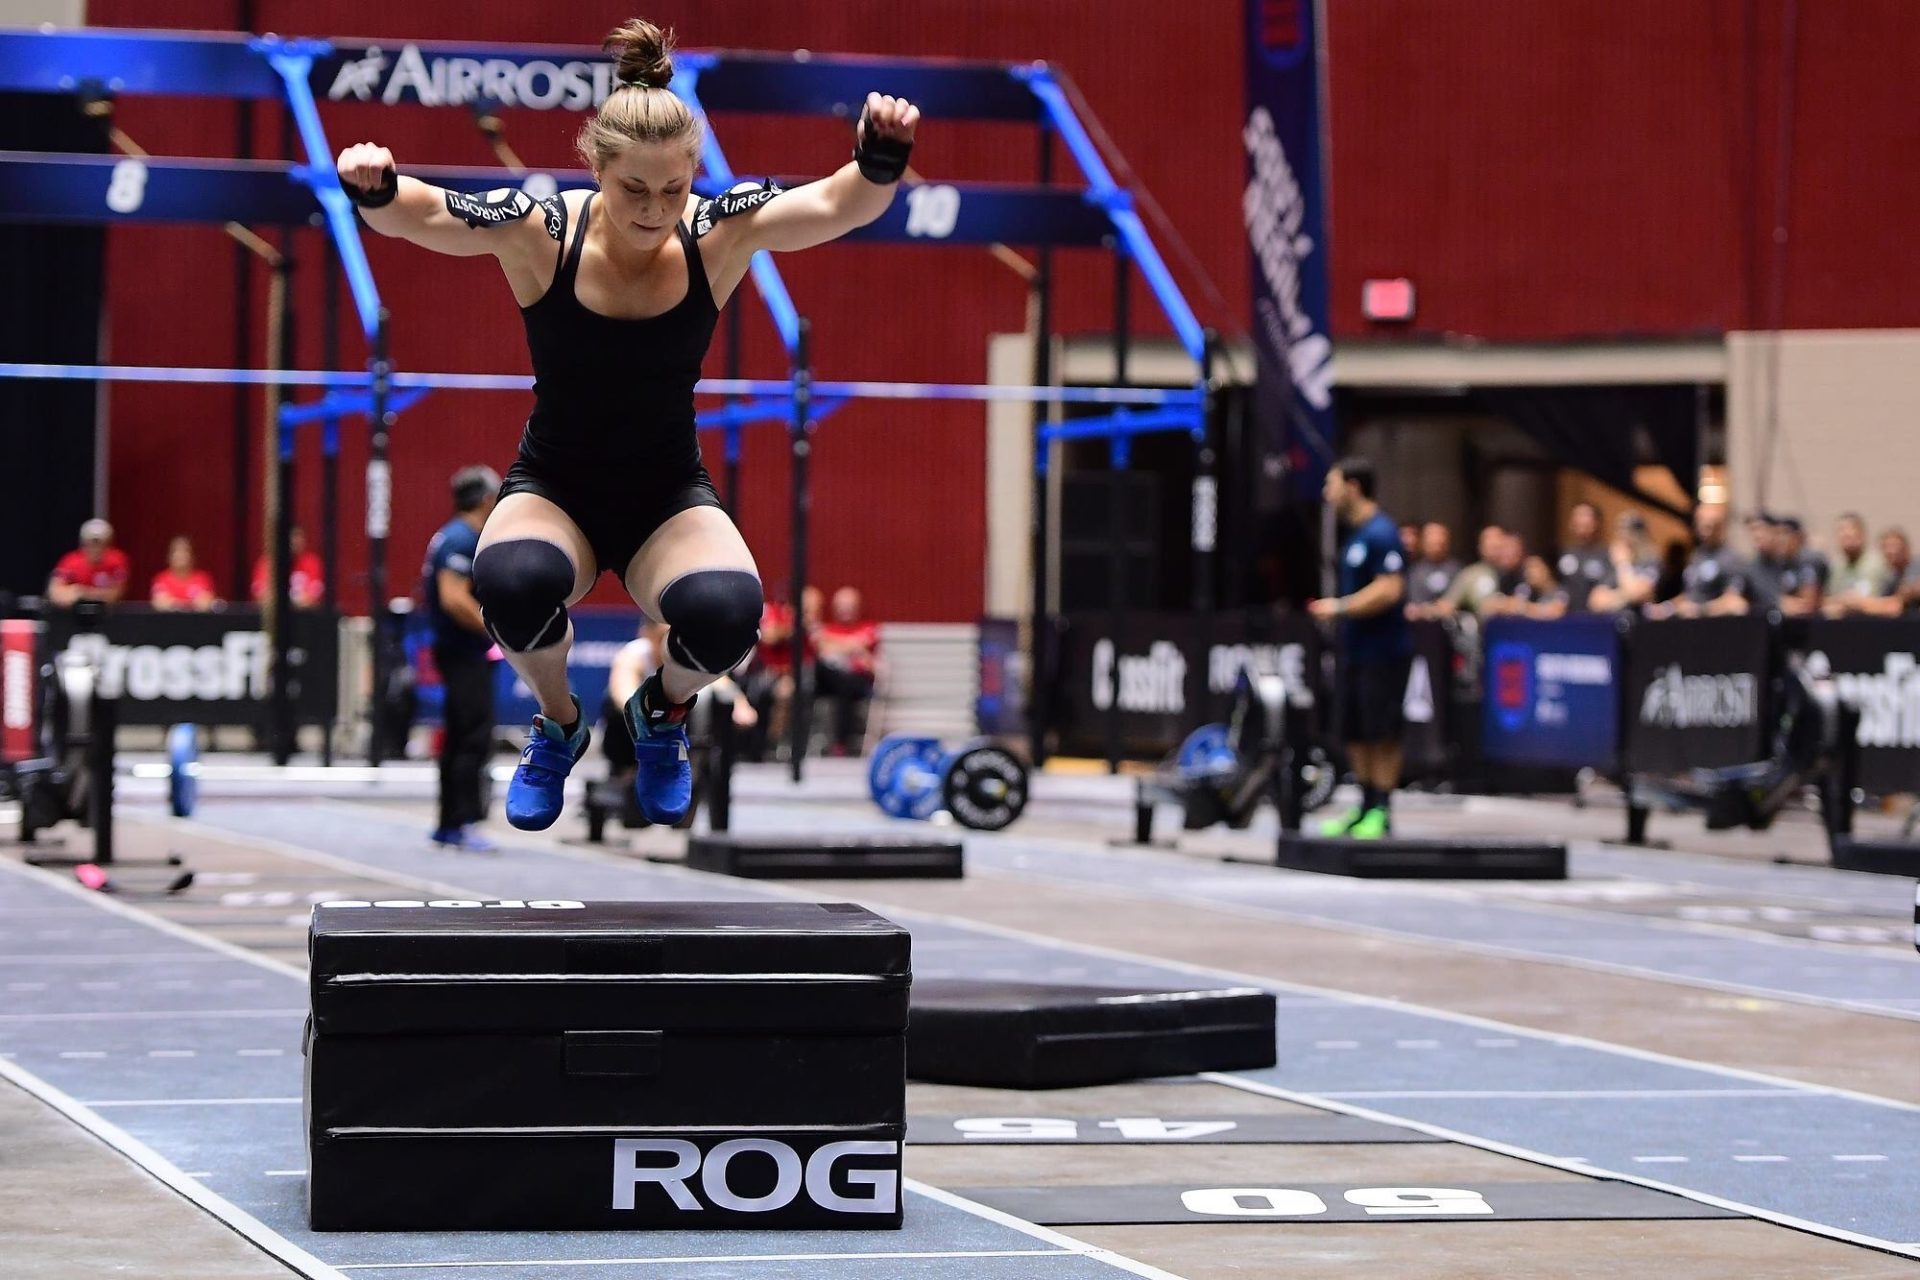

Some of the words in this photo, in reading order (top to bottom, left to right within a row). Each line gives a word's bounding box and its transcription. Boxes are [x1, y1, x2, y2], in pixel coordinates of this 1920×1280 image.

[105, 159, 149, 213] 8
[449, 194, 519, 222] AIRROSTI
[905, 184, 962, 238] 10
[953, 1117, 1237, 1139] 45
[611, 1137, 899, 1213] ROG
[1180, 1187, 1495, 1216] 50
